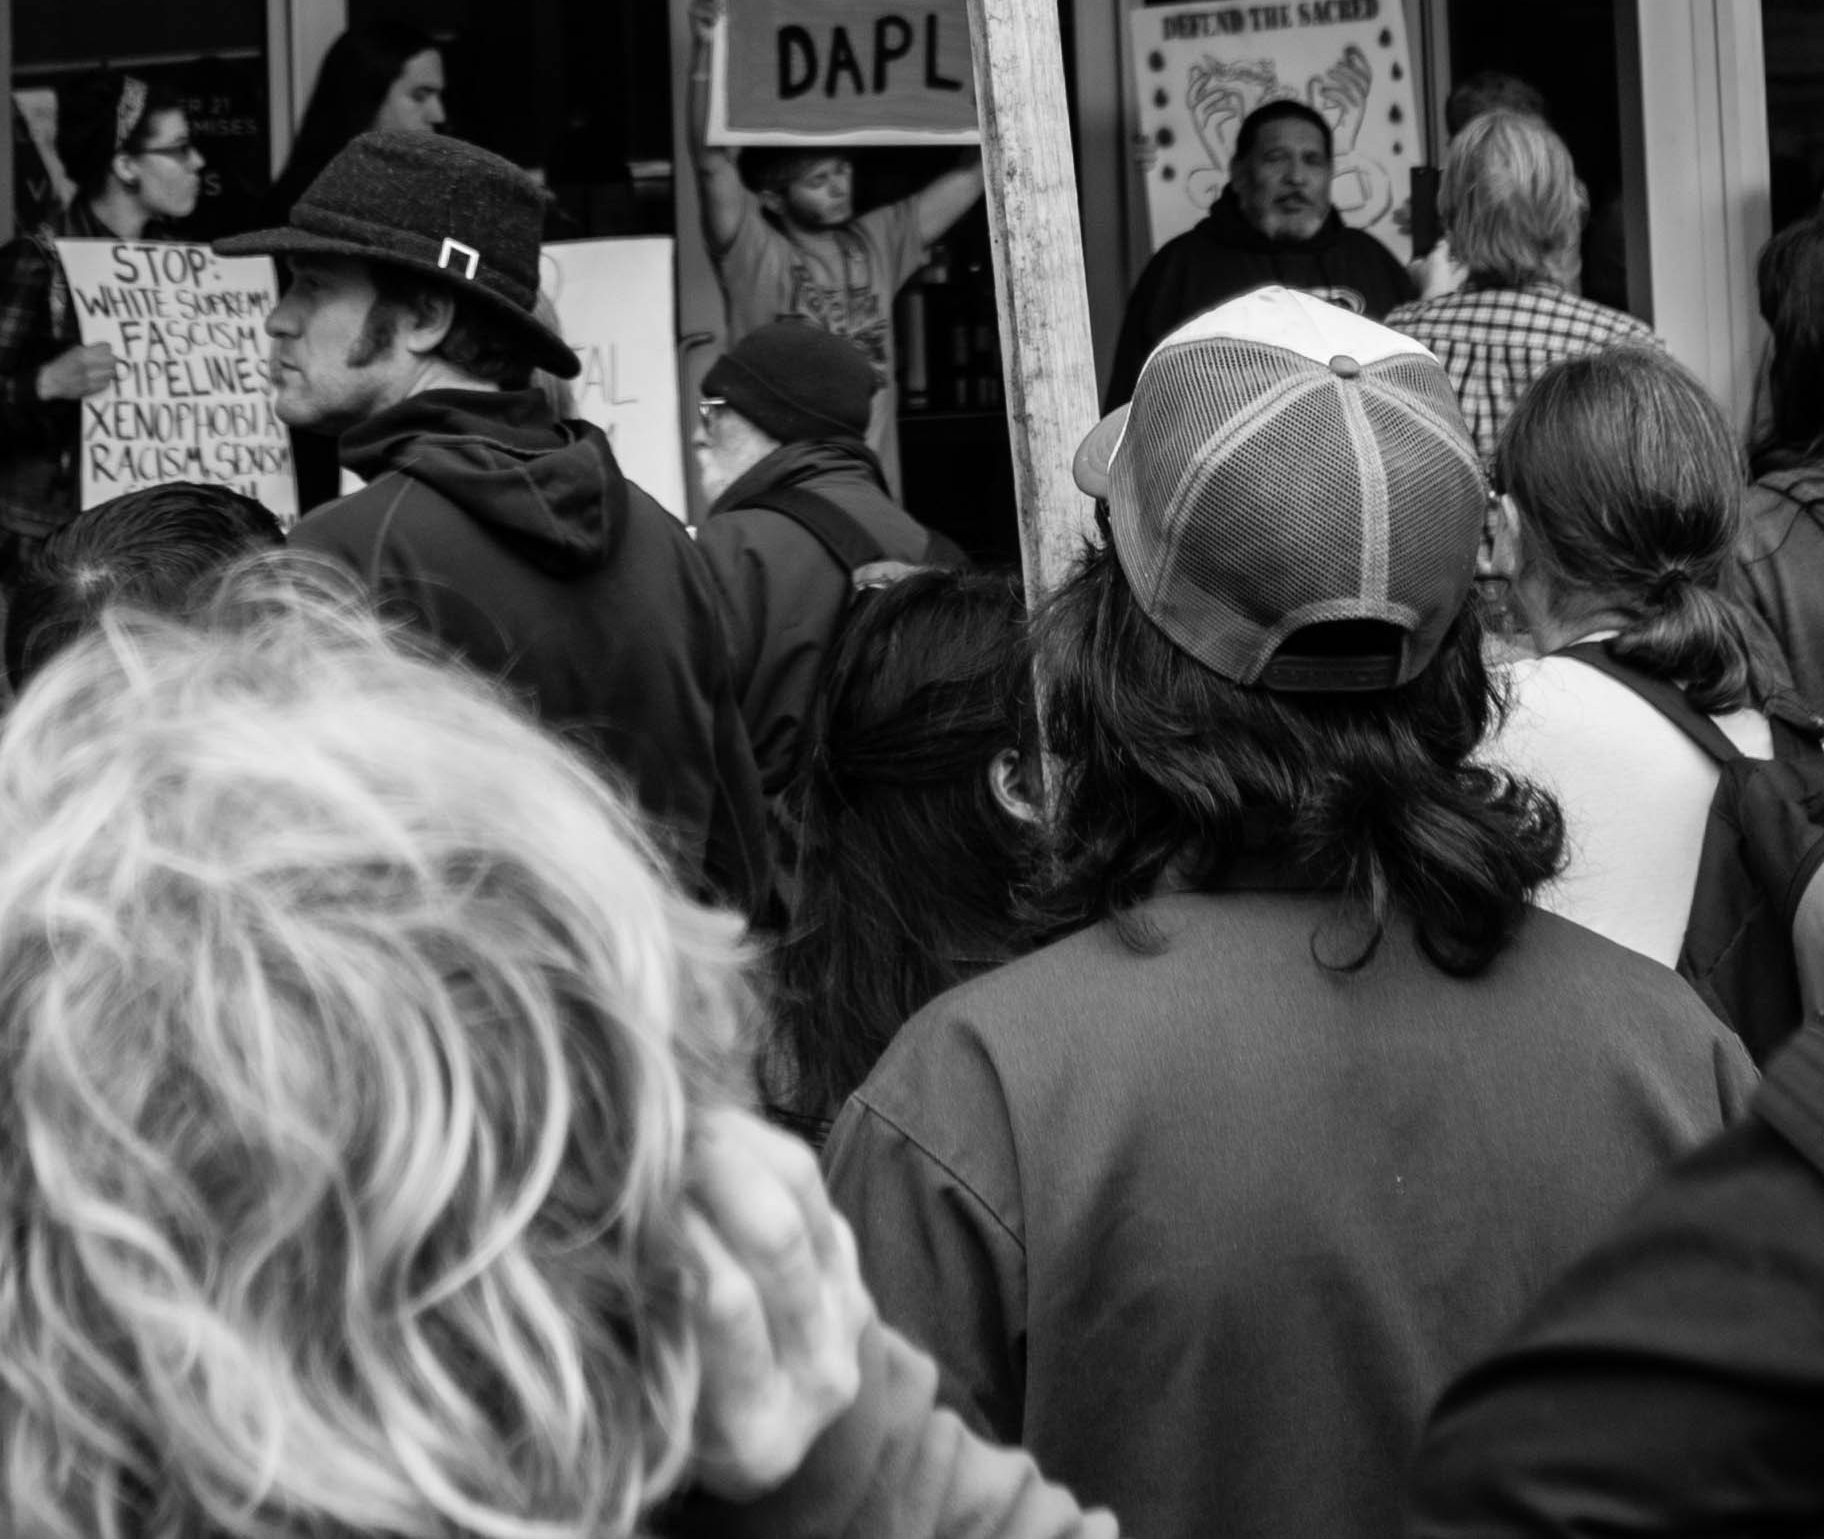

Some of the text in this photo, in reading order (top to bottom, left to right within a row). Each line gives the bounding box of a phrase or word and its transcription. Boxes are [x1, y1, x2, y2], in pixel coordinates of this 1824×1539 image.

[1161, 8, 1246, 42] DEFEND
[1247, 4, 1293, 33] THE
[778, 12, 964, 100] DAPL
[75, 285, 171, 319] WHITE
[120, 319, 260, 361] FASCISM
[112, 355, 274, 399] PIPELINES
[85, 399, 282, 445] XENOPHOBIA
